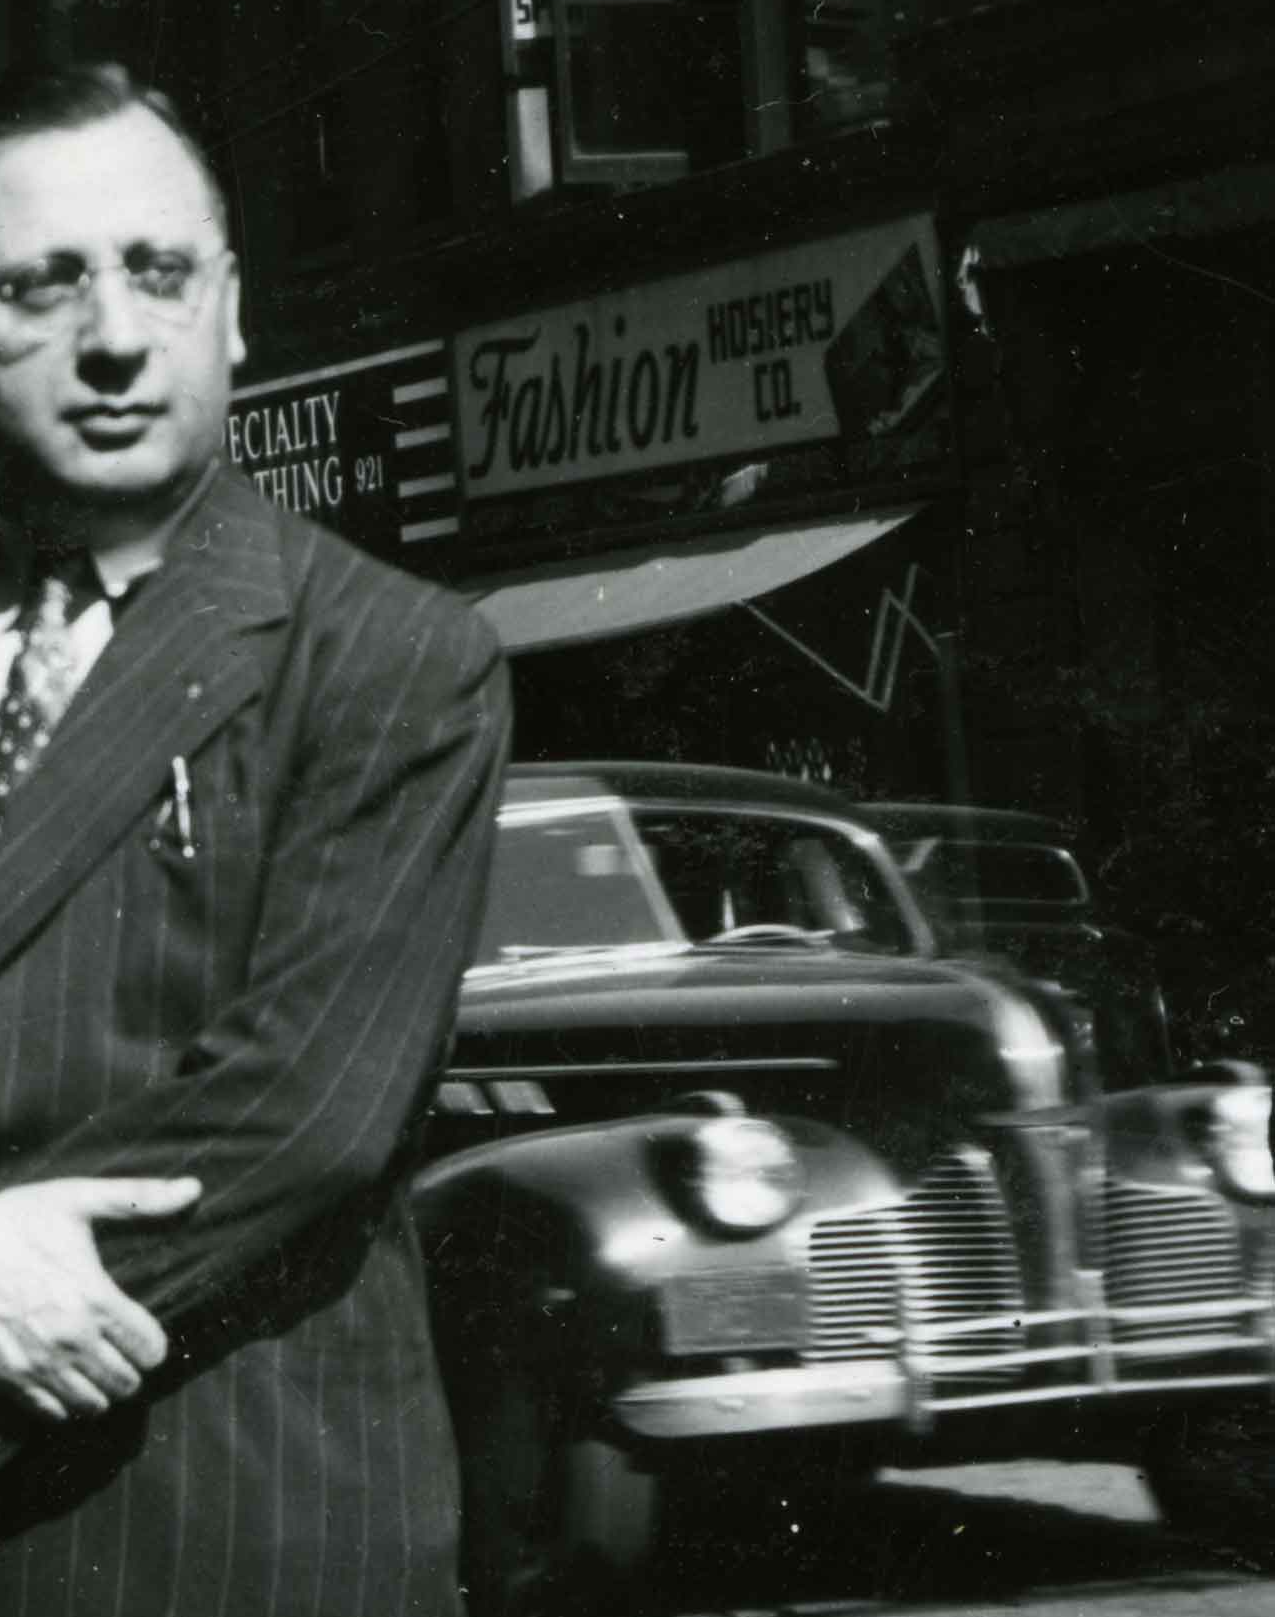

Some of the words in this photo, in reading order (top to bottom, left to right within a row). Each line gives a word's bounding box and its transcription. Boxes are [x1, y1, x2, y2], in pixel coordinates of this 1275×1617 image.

[469, 314, 701, 480] Fashion
[706, 278, 835, 365] HOSIERY
[222, 390, 341, 464] ECIALTY
[355, 456, 383, 493] 921
